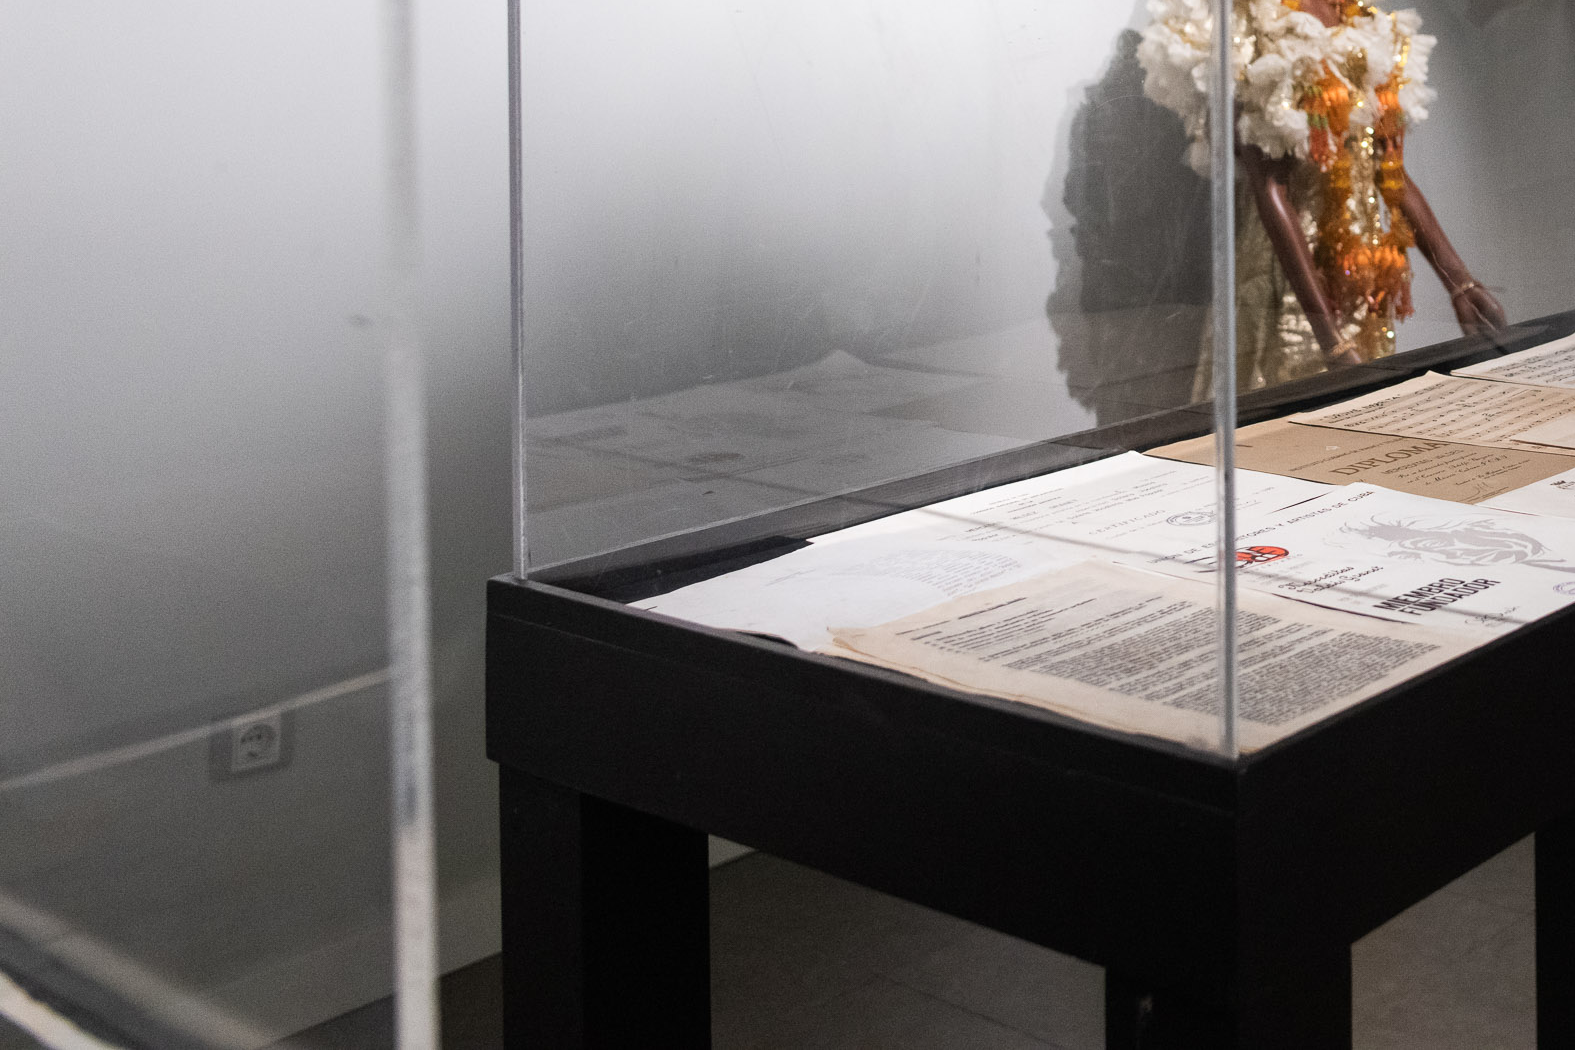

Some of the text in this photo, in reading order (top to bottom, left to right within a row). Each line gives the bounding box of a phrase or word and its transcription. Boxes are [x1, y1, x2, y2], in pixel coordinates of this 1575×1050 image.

[1328, 441, 1450, 476] DIPLOMA
[1286, 507, 1333, 525] ARTISTAS
[1331, 501, 1349, 509] DE
[1347, 490, 1376, 502] CUBA
[1372, 576, 1466, 611] MIEMBRO
[1398, 577, 1502, 616] FUNDADOR
